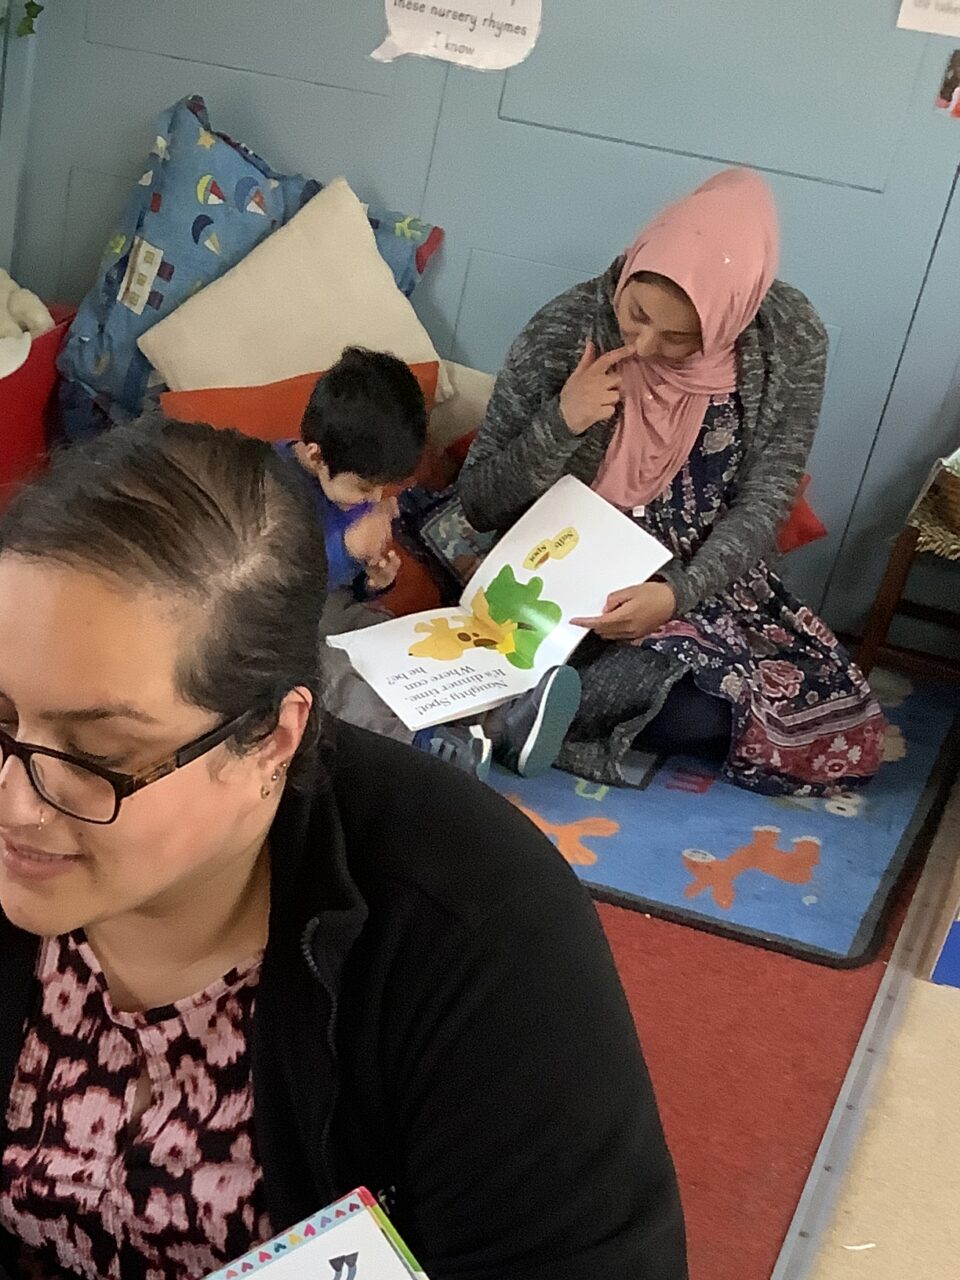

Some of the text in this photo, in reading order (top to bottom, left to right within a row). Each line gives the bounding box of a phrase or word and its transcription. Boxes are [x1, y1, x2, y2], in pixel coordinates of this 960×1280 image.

[430, 6, 478, 32] nursery
[482, 10, 528, 38] rhymes
[445, 34, 475, 55] know
[386, 666, 428, 686] he be?
[403, 665, 476, 691] Where can
[442, 673, 484, 692] dinner
[484, 668, 507, 679] It's
[415, 680, 509, 716] Naughty Spot!
